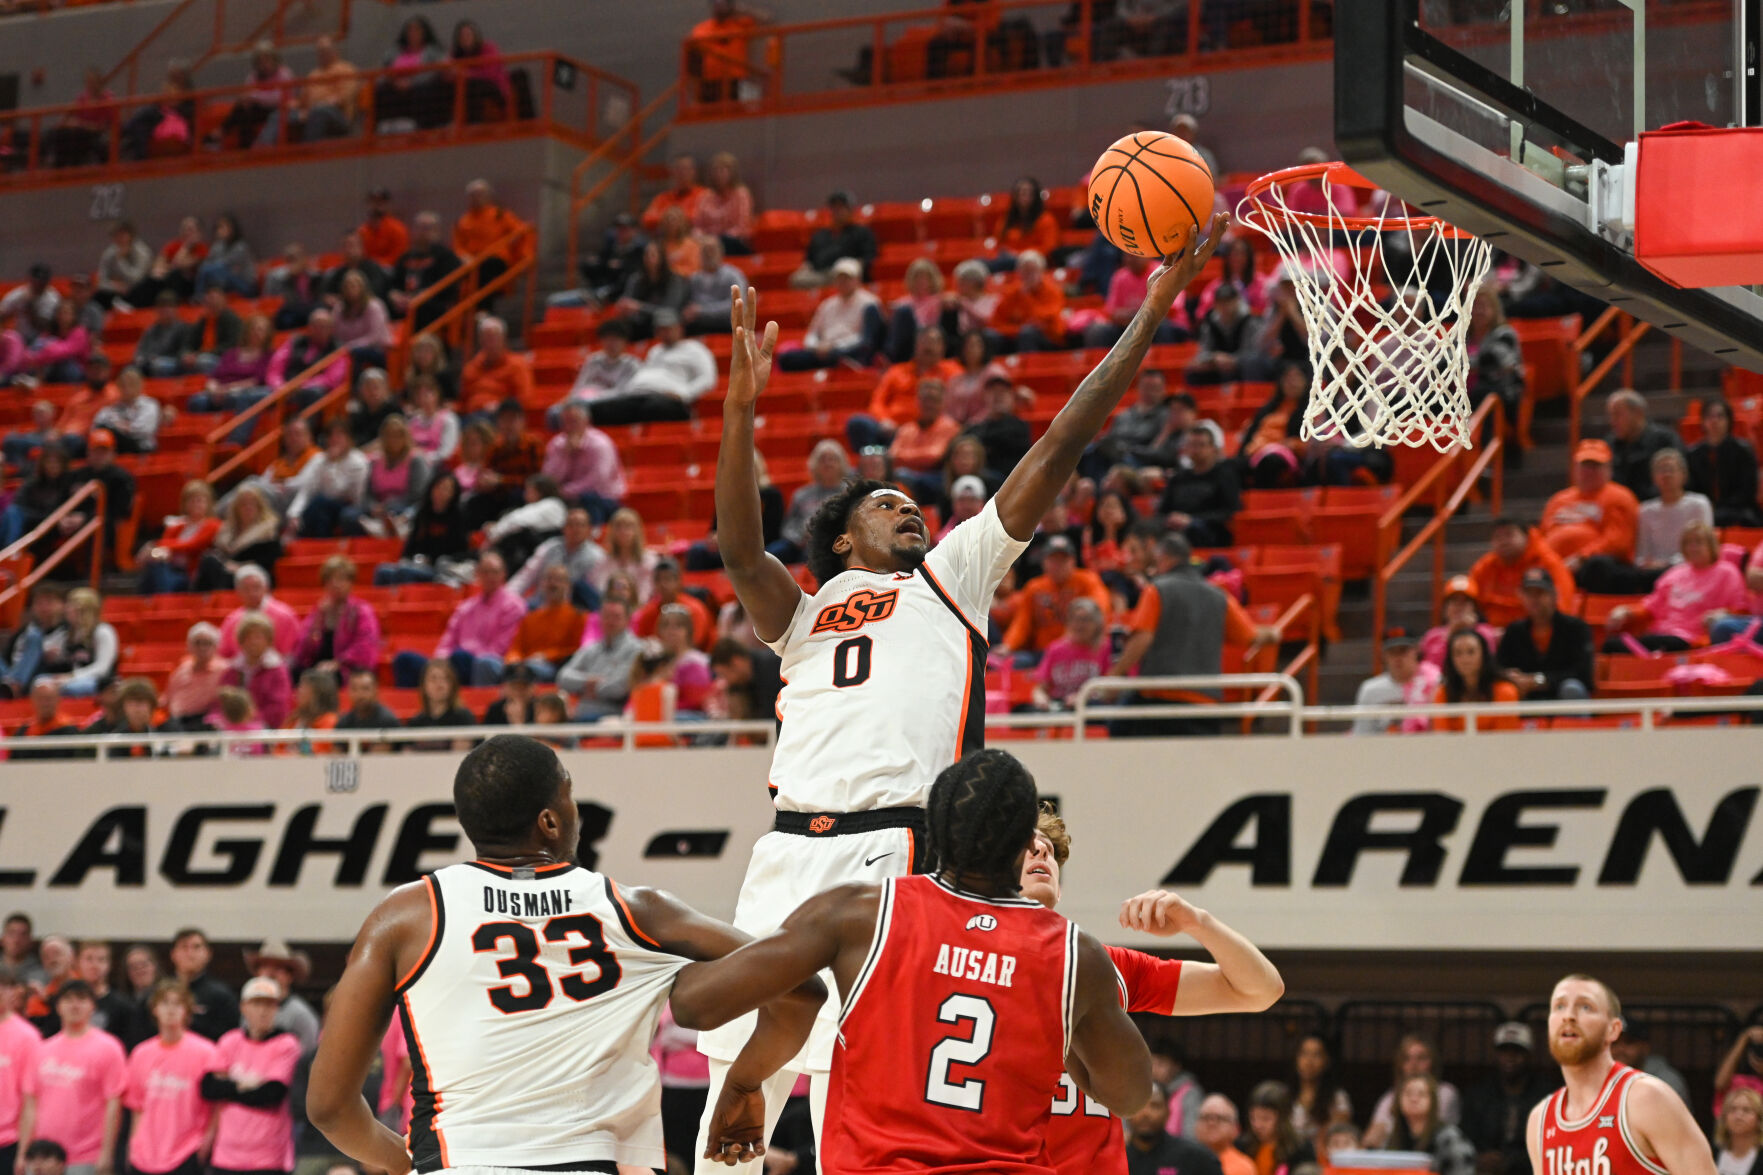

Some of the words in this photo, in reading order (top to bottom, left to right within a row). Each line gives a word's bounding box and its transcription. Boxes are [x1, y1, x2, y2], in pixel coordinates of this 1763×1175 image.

[809, 588, 899, 636] OSU
[832, 634, 873, 688] 0
[0, 803, 616, 887] AGHE
[809, 815, 836, 833] OSU
[1159, 786, 1763, 887] AREN
[471, 912, 623, 1015] 33
[933, 943, 1017, 988] AUSAR
[924, 992, 997, 1114] 2
